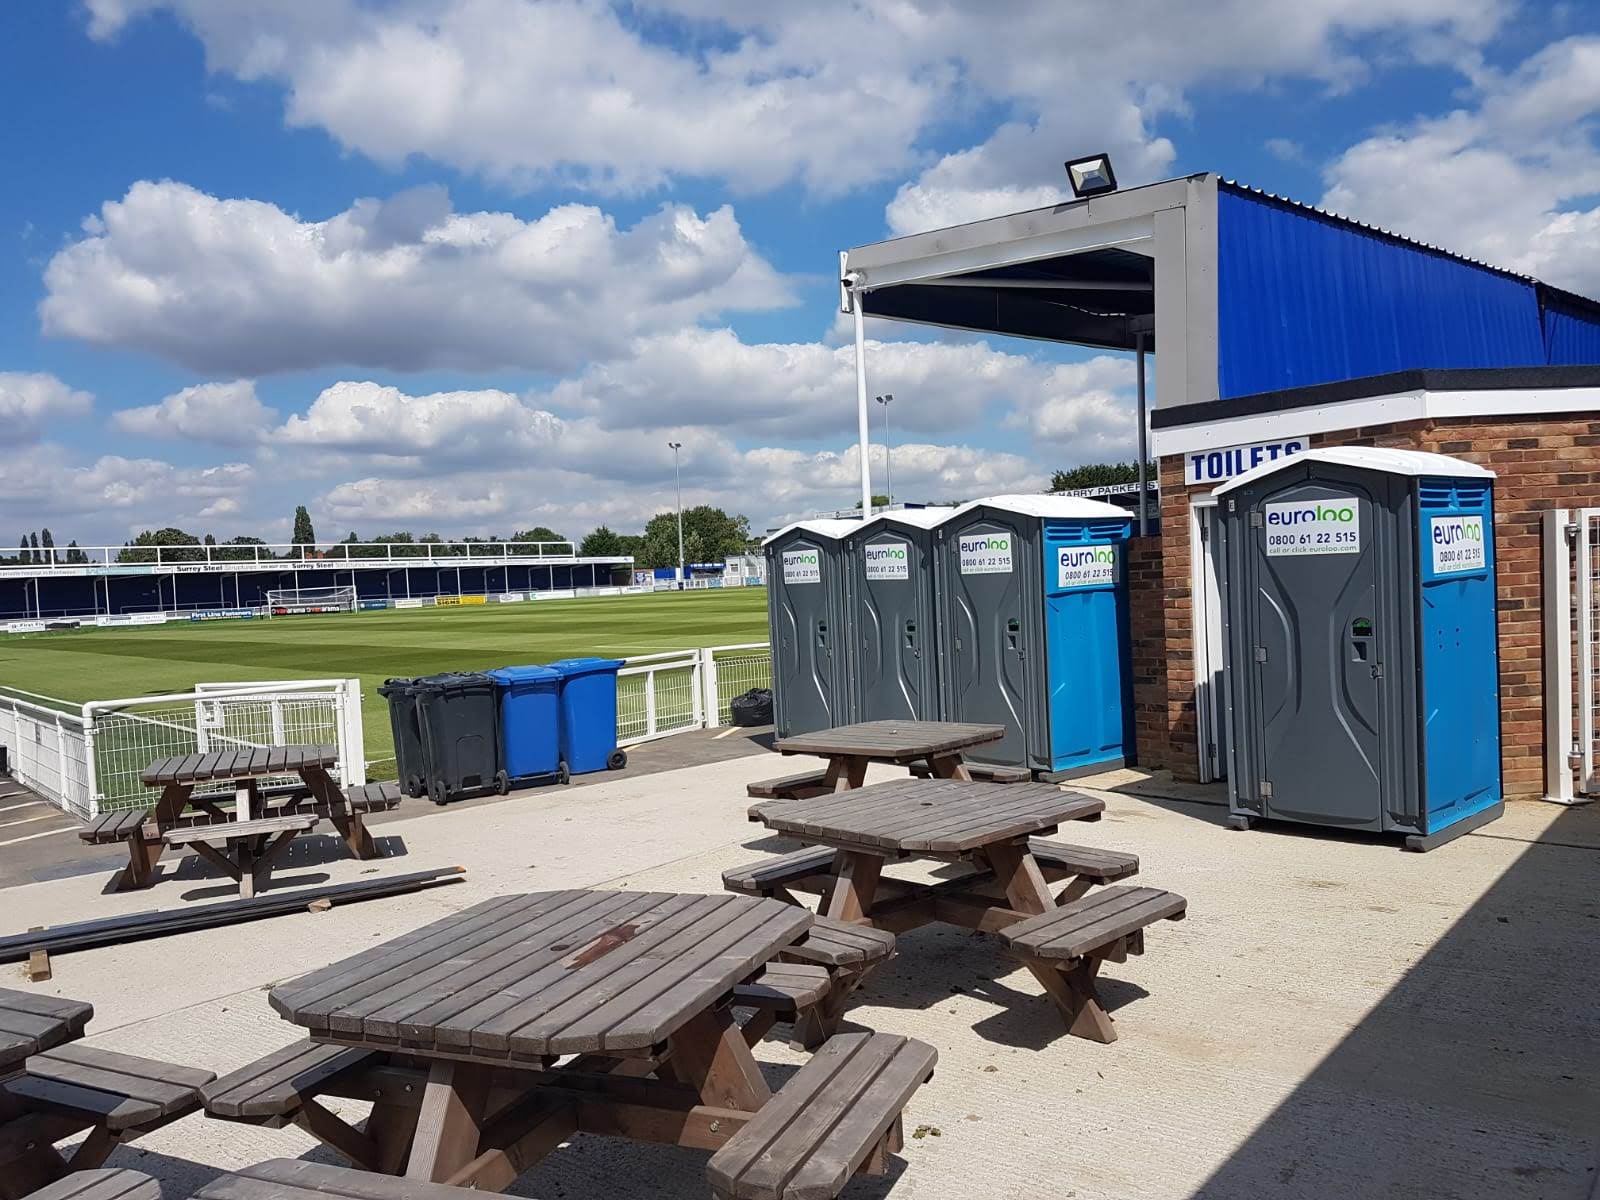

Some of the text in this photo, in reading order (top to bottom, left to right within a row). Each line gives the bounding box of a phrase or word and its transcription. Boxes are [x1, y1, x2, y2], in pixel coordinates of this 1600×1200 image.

[1268, 505, 1354, 525] euroloo
[1433, 517, 1481, 545] euroloo
[961, 537, 1008, 552] euroloo
[1269, 532, 1356, 545] 0800 61 22 515
[866, 547, 905, 560] euroloo
[1309, 545, 1357, 553] euroloo.com
[1440, 548, 1481, 562] 0800 61 22 515
[962, 557, 1011, 567] 0800 61 22 515
[1060, 547, 1116, 567] euroloo
[1083, 570, 1090, 579] 61
[1092, 569, 1100, 578] 22
[1102, 568, 1113, 577] 515
